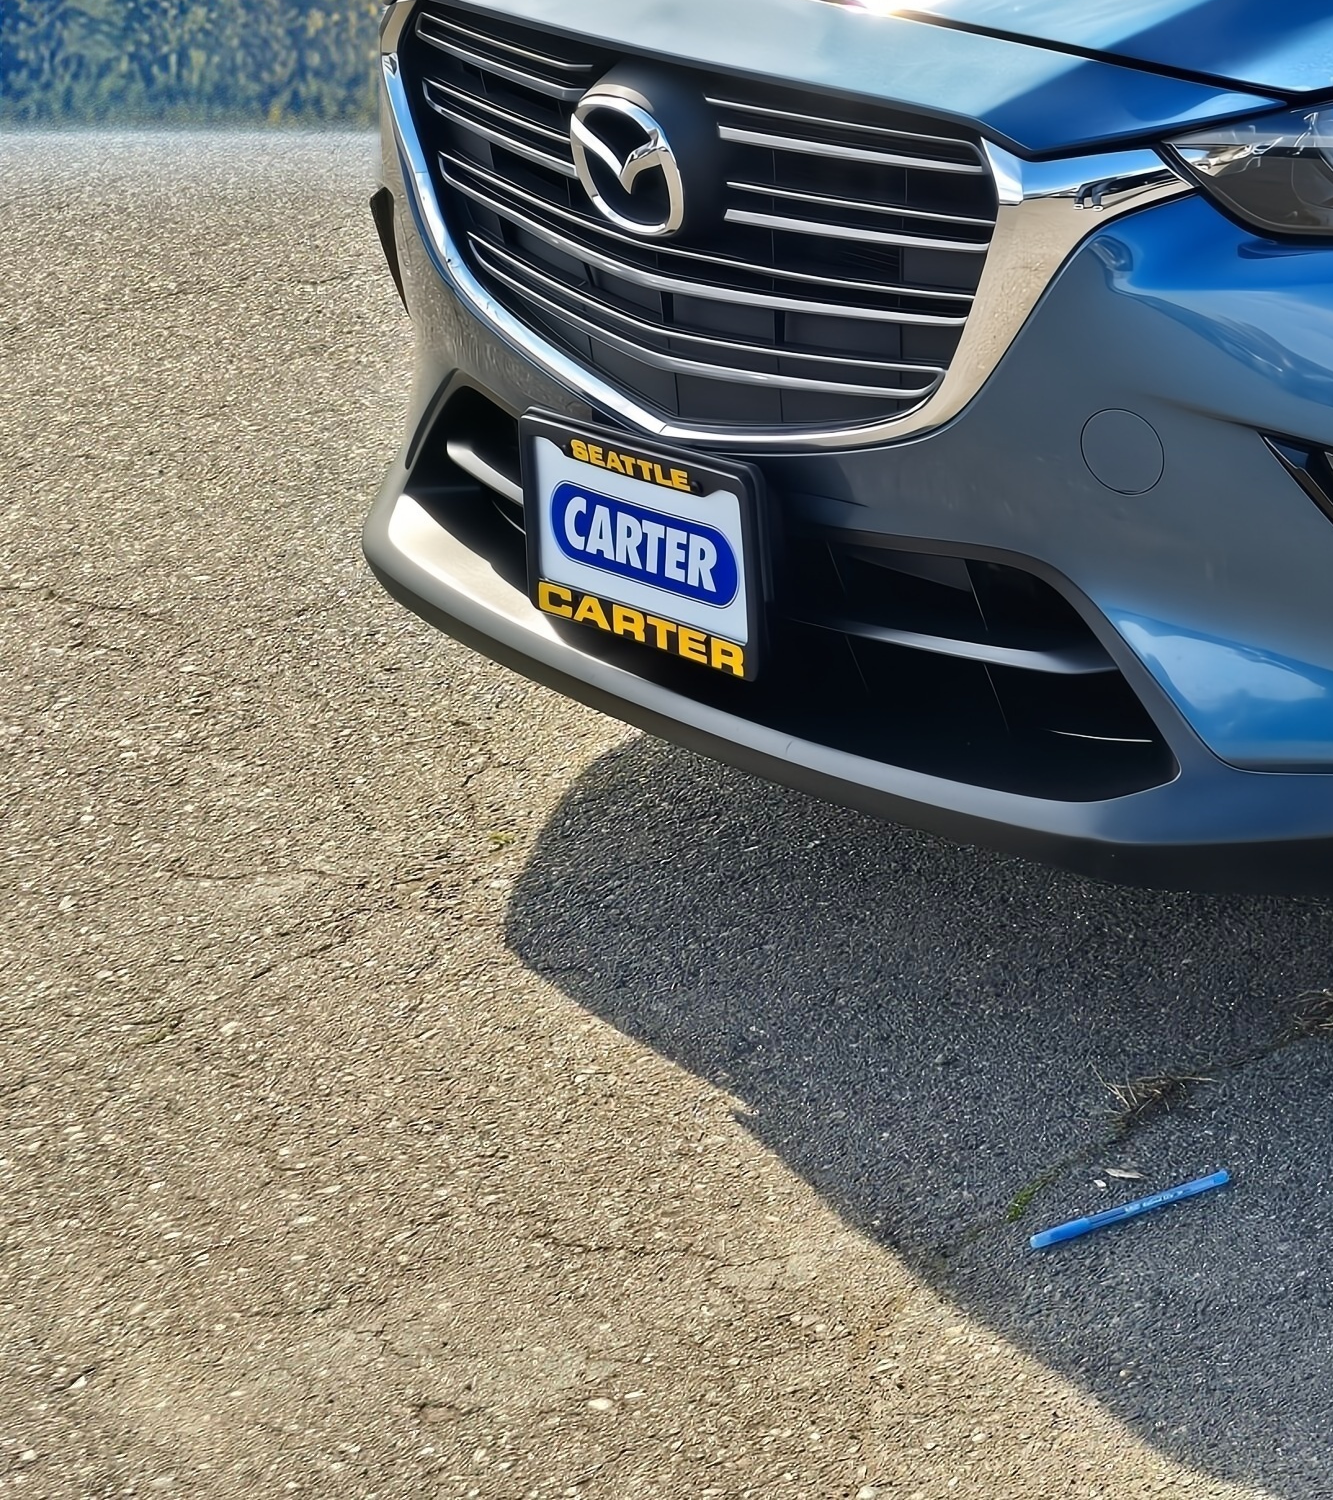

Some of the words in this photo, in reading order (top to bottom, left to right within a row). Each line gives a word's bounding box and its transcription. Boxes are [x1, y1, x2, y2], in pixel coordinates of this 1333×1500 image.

[569, 438, 691, 492] SEATTLE
[564, 496, 718, 593] CARTER
[538, 580, 745, 678] CARTER
